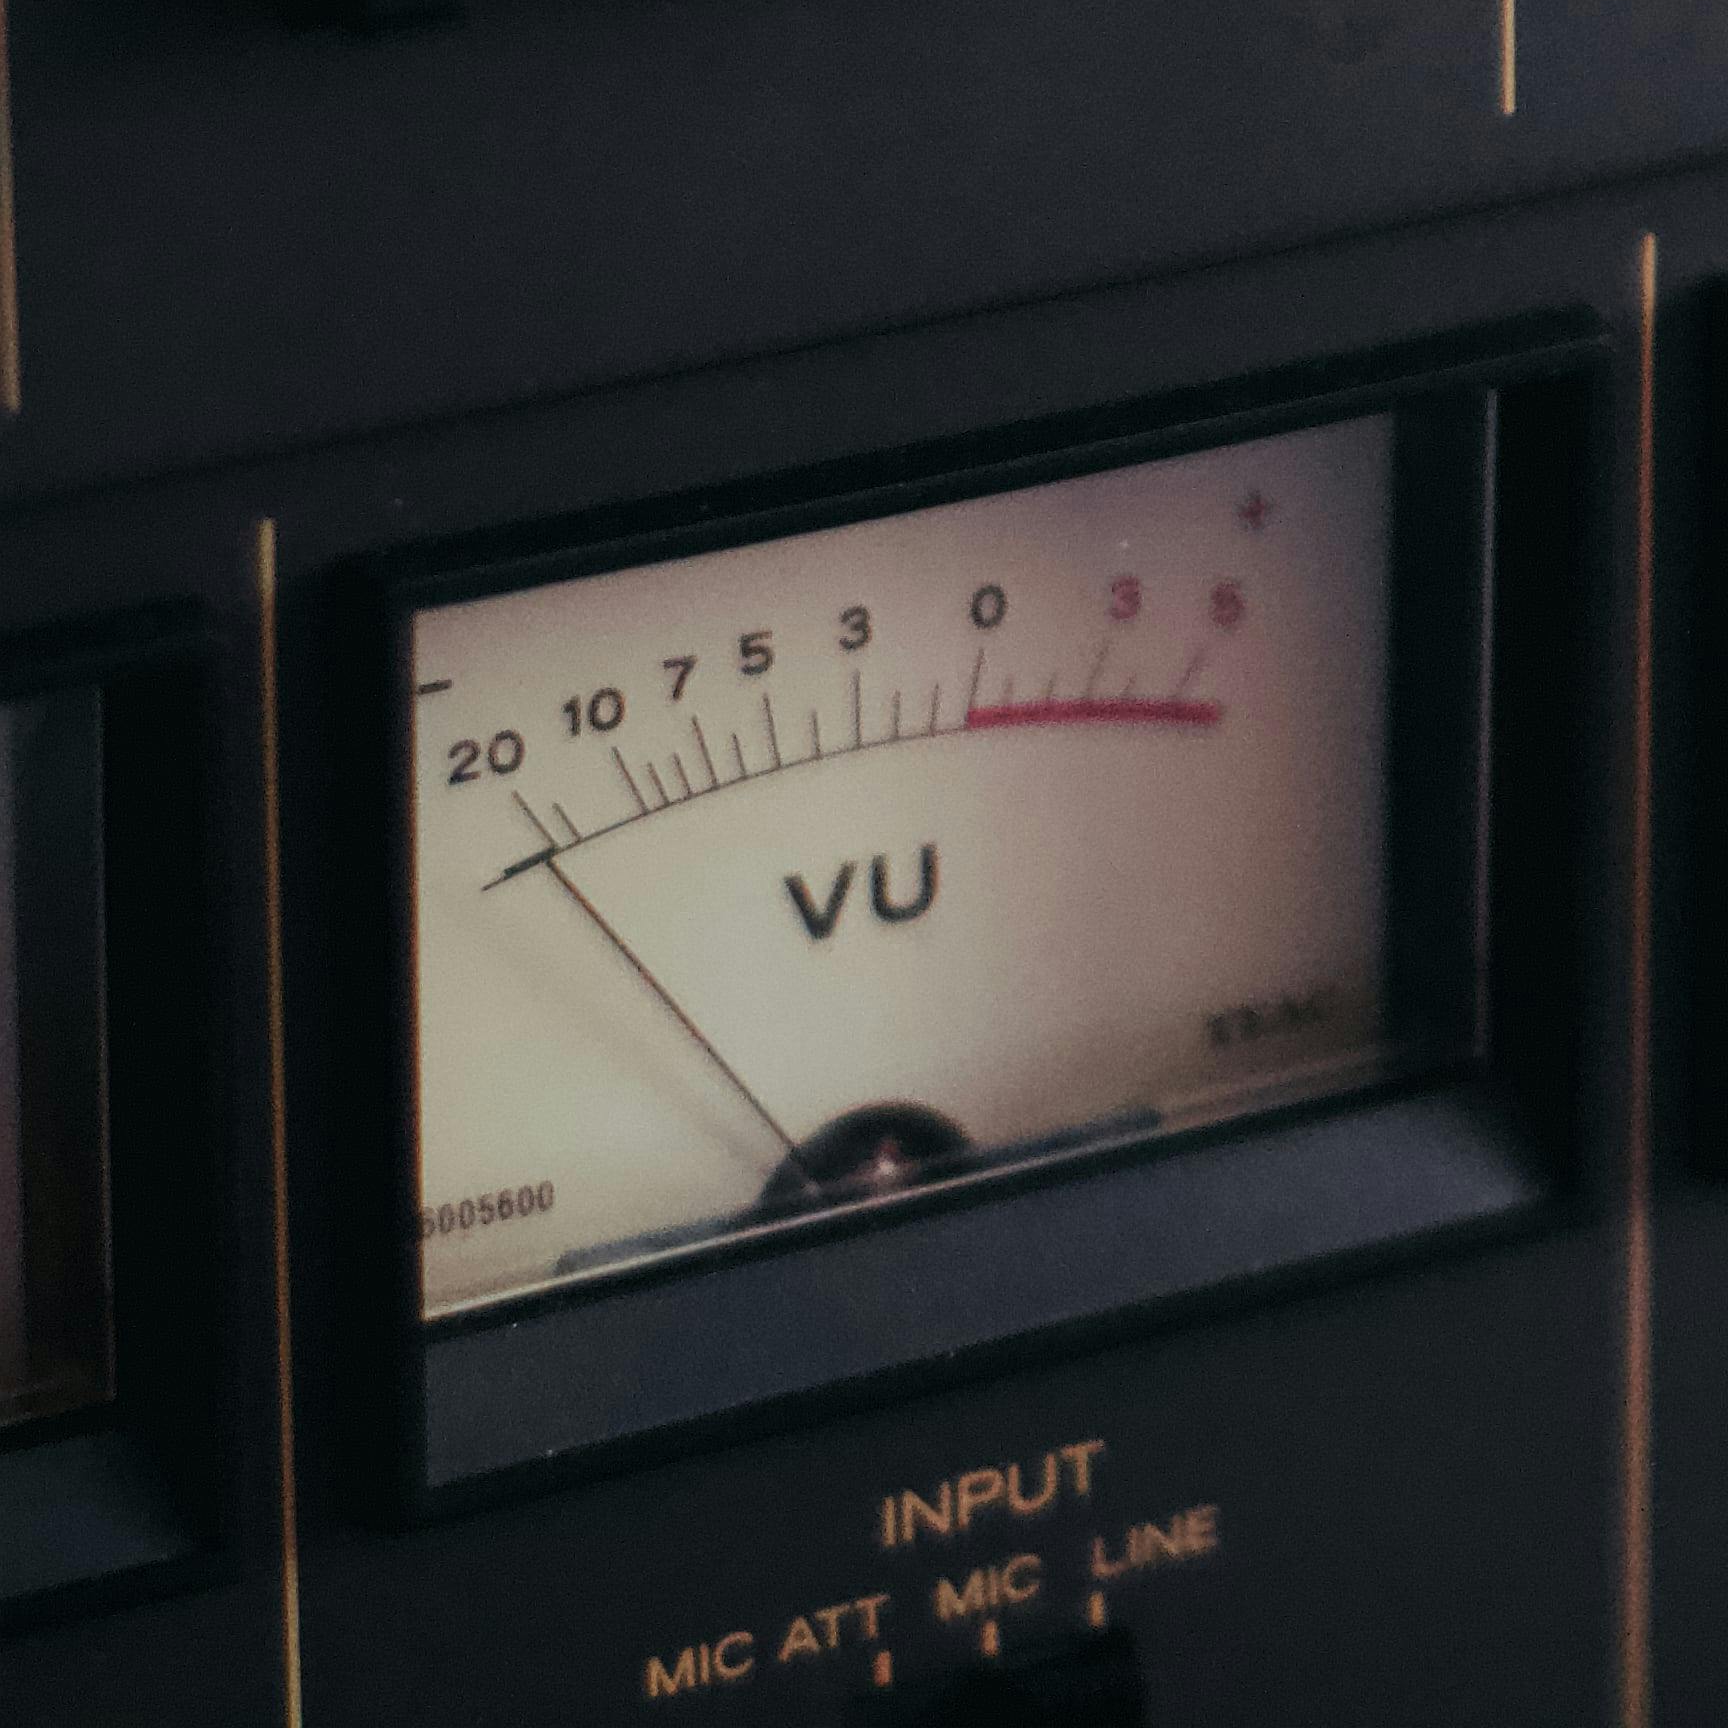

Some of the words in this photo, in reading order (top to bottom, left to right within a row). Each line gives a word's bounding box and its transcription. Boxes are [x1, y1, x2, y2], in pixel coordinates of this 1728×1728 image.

[448, 730, 525, 786] 20
[563, 688, 625, 736] 10
[663, 656, 696, 701] 7
[740, 631, 773, 675] 5
[839, 606, 871, 652] 3
[970, 584, 1007, 629] 0
[1109, 575, 1141, 622] 3
[784, 845, 938, 941] VU
[882, 1441, 1103, 1548] INPUT
[646, 1631, 752, 1697] MIC
[779, 1595, 888, 1665] ATT
[936, 1554, 1039, 1618] MIC
[1092, 1507, 1215, 1577] LINE
